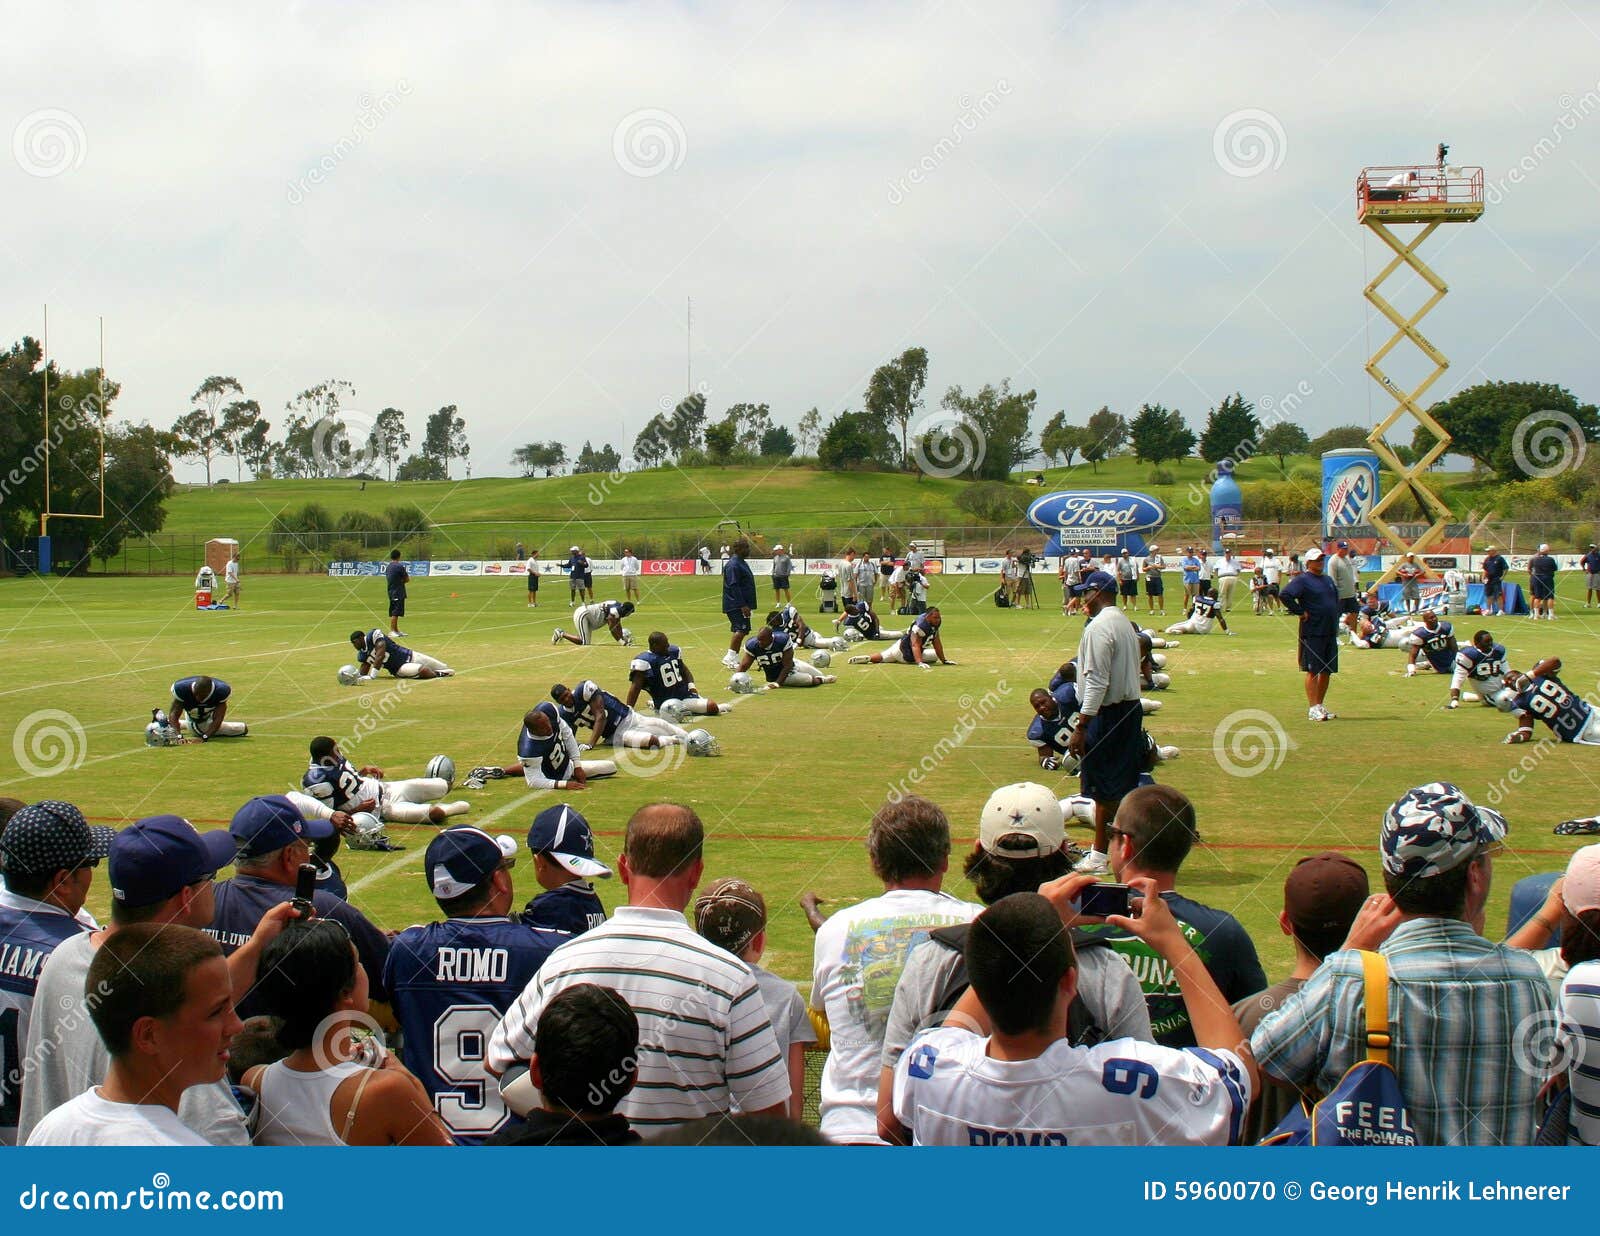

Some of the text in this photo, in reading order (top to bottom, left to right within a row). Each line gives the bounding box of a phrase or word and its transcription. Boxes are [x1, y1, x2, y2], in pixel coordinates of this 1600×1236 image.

[1057, 497, 1138, 526] Ford
[650, 561, 685, 572] CORT
[1529, 679, 1568, 719] 99
[436, 947, 509, 982] ROMO
[434, 1004, 511, 1136] 9
[1102, 1057, 1159, 1099] 9
[1336, 1101, 1415, 1134] FEEL
